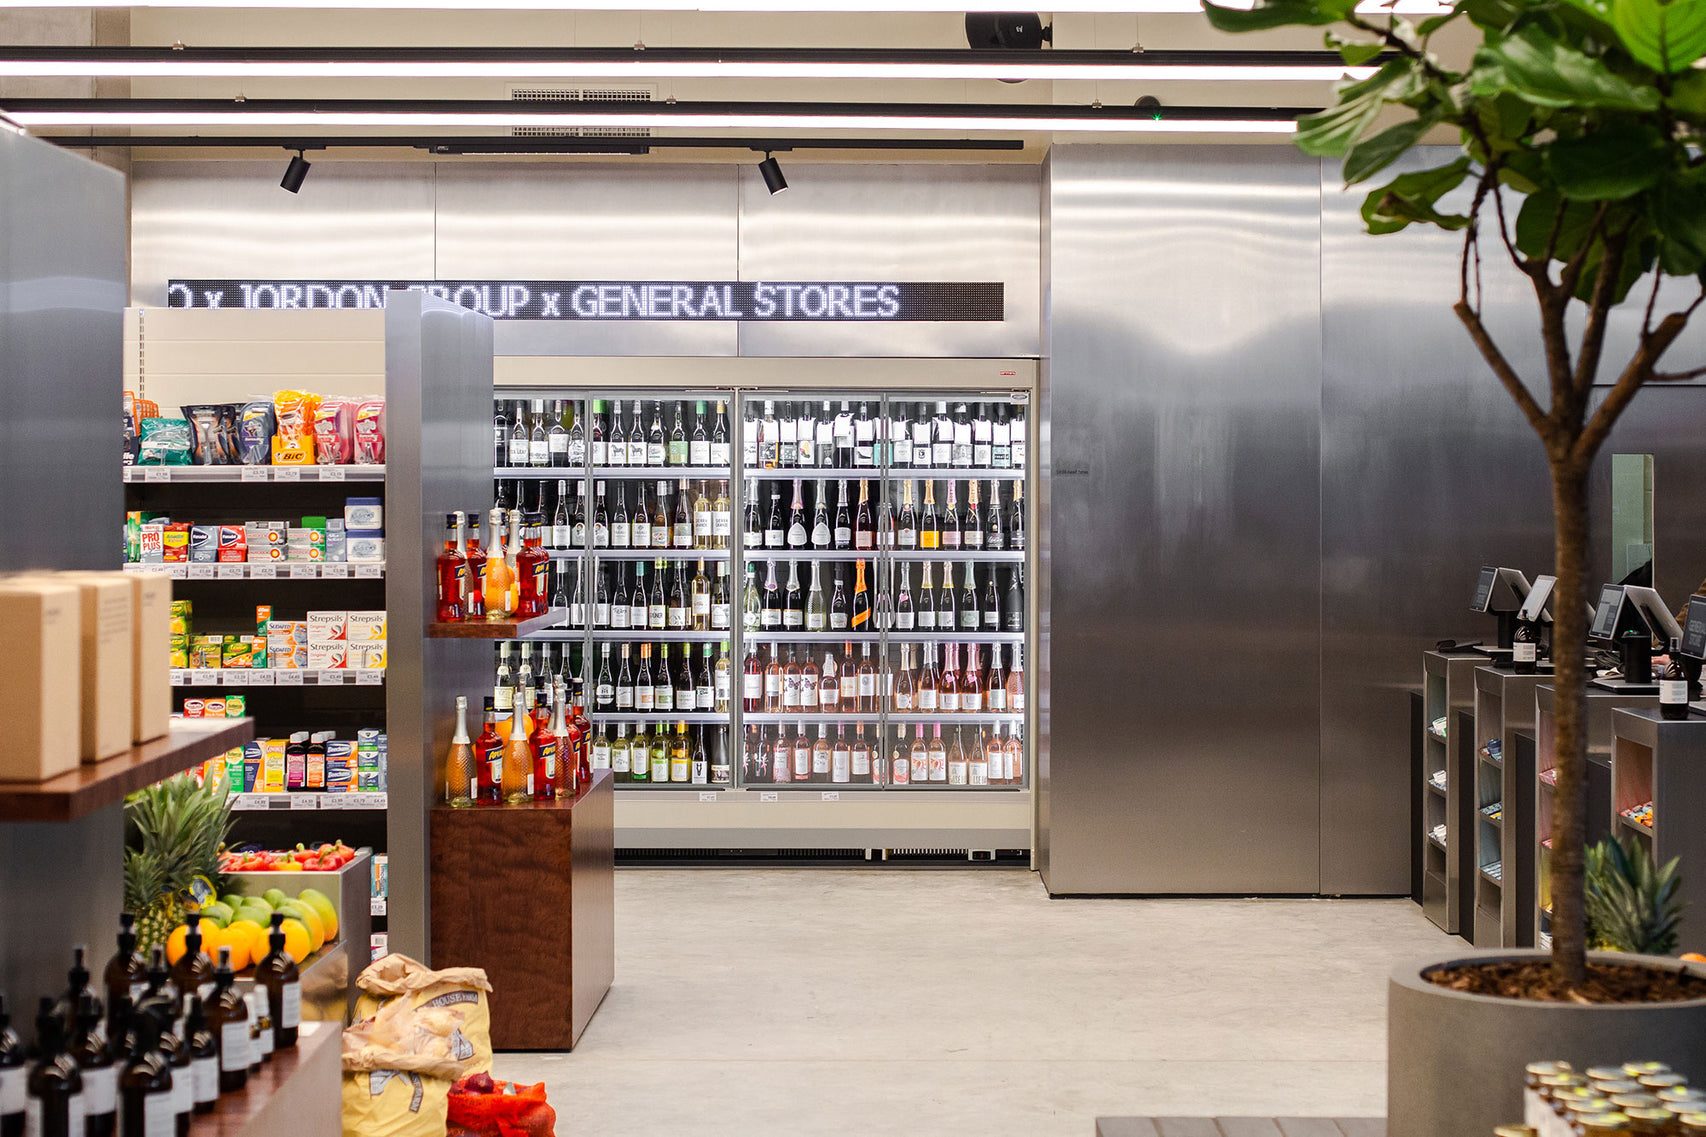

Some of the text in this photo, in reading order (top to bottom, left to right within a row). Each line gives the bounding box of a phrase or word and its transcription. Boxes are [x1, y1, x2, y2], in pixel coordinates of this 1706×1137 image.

[406, 285, 530, 317] OUP
[541, 292, 560, 317] x
[571, 285, 743, 317] GENERAL
[754, 283, 899, 317] STORES
[142, 532, 160, 543] PRO
[143, 542, 161, 551] PLUS
[309, 615, 343, 623] Strepsils
[350, 615, 383, 623] Strepsils
[310, 643, 344, 652] Strepsils
[350, 643, 383, 652] Strepsils
[432, 992, 462, 1008] HOUSE
